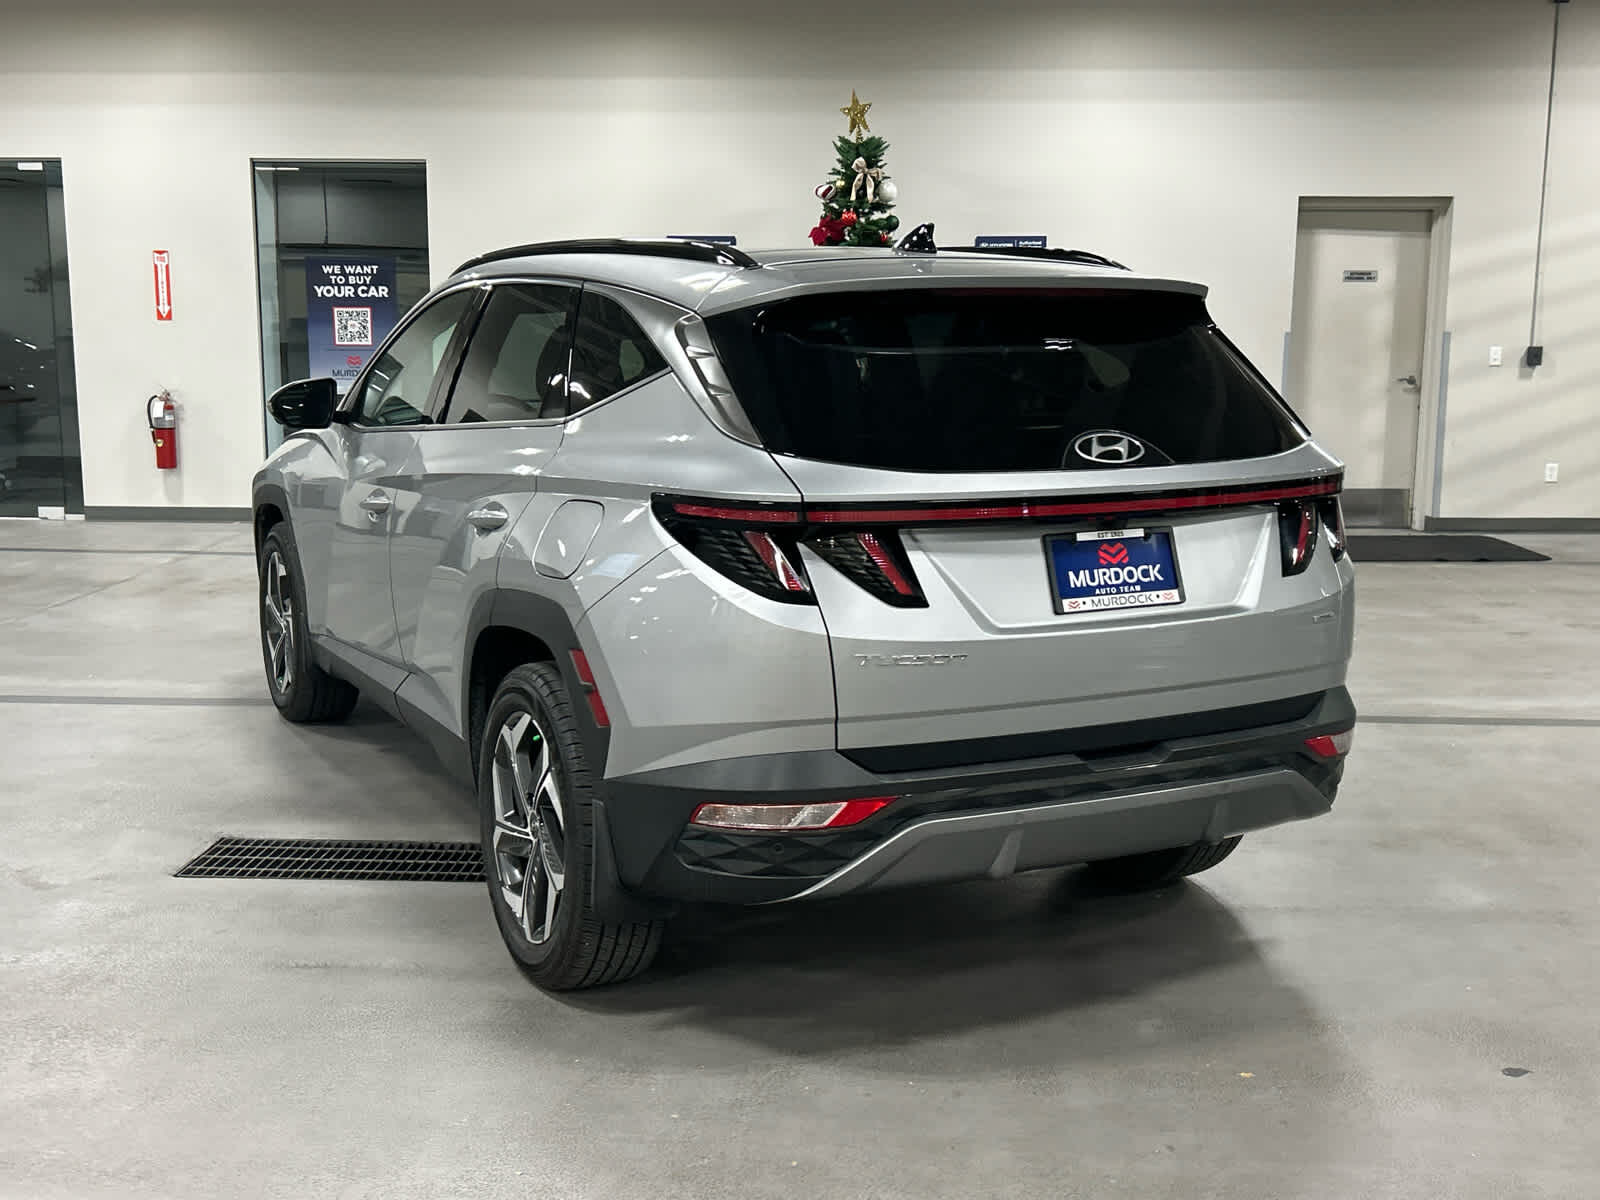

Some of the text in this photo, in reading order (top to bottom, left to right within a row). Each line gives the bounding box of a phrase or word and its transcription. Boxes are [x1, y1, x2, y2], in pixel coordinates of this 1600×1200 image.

[321, 265, 379, 274] WE WANT
[329, 275, 372, 284] TO BUY
[313, 285, 389, 298] YOUR CAR
[331, 368, 361, 377] MURD
[1068, 564, 1164, 588] MURDOCK
[1095, 585, 1141, 595] AUTO TEAM
[1090, 593, 1154, 608] MURDOCK
